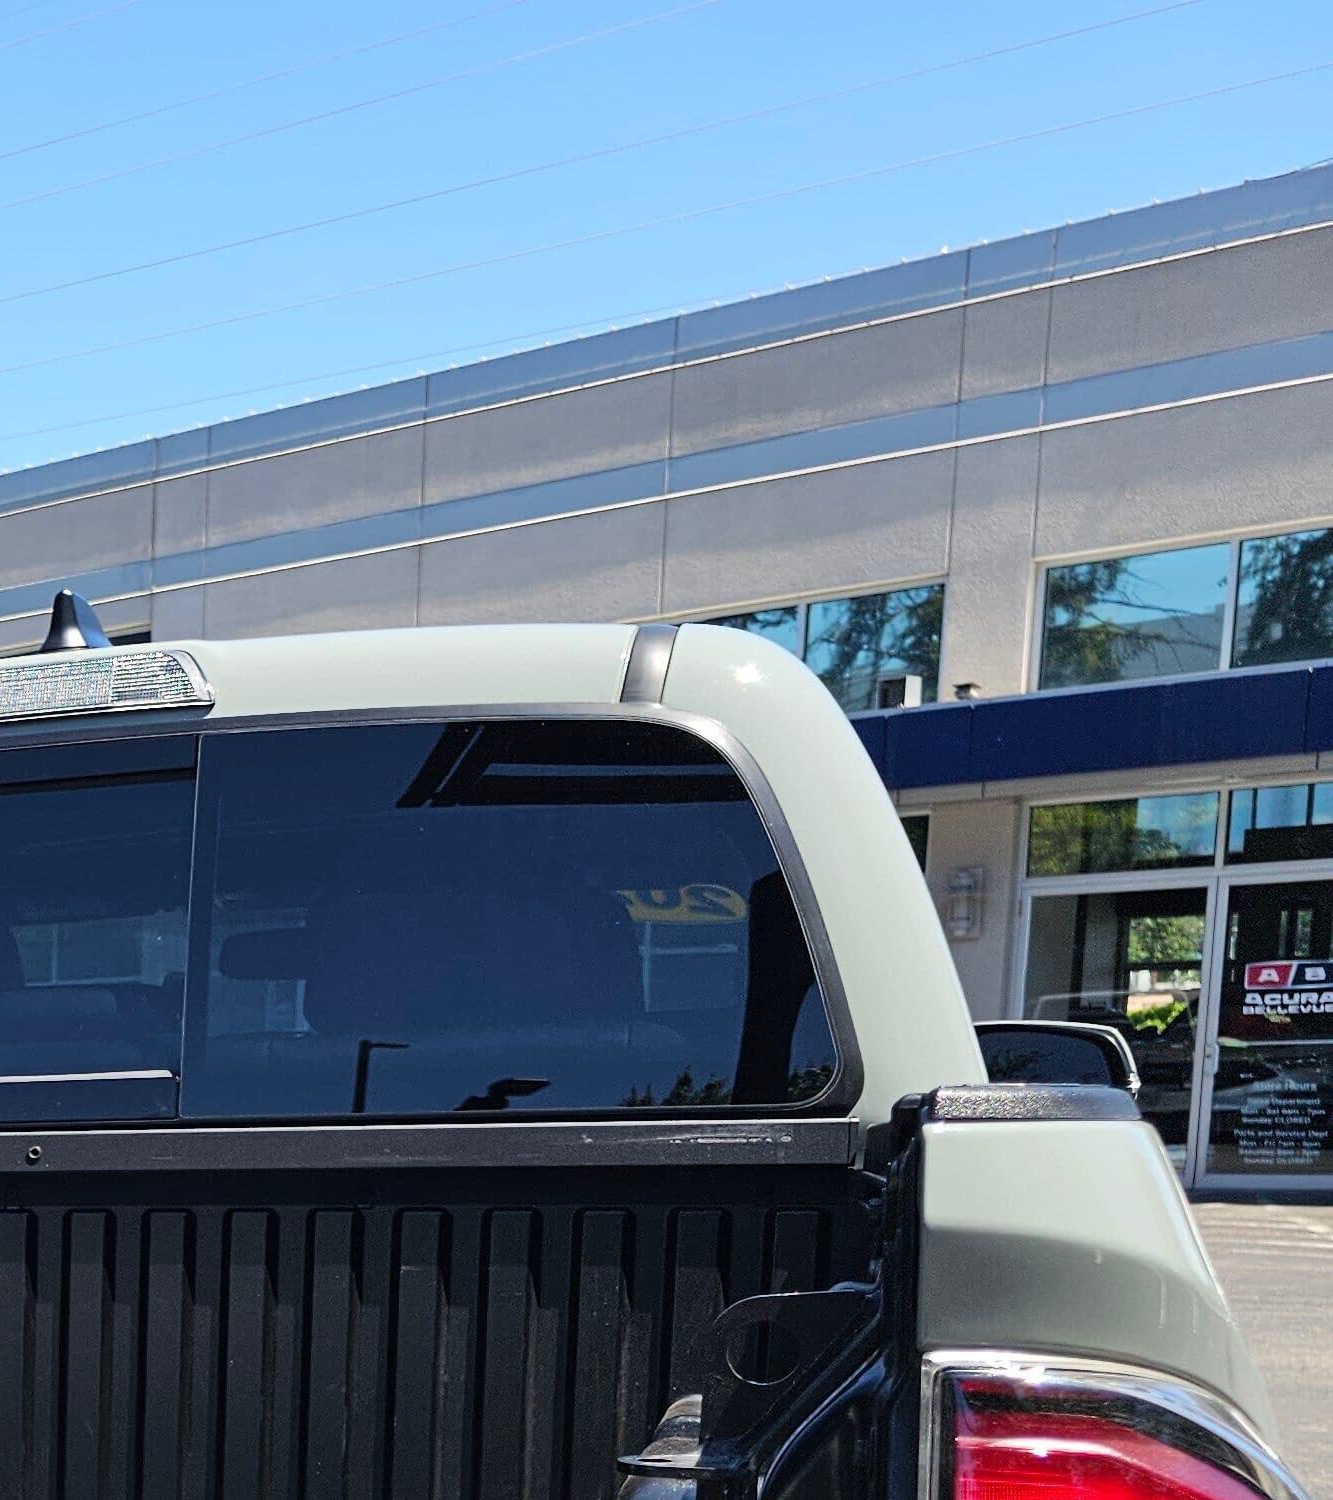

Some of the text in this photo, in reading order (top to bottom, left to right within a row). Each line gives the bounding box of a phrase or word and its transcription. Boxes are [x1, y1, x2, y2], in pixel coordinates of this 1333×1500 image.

[1259, 967, 1280, 982] A
[1244, 992, 1333, 1005] ACURA
[1242, 1003, 1333, 1015] BELLEVUE
